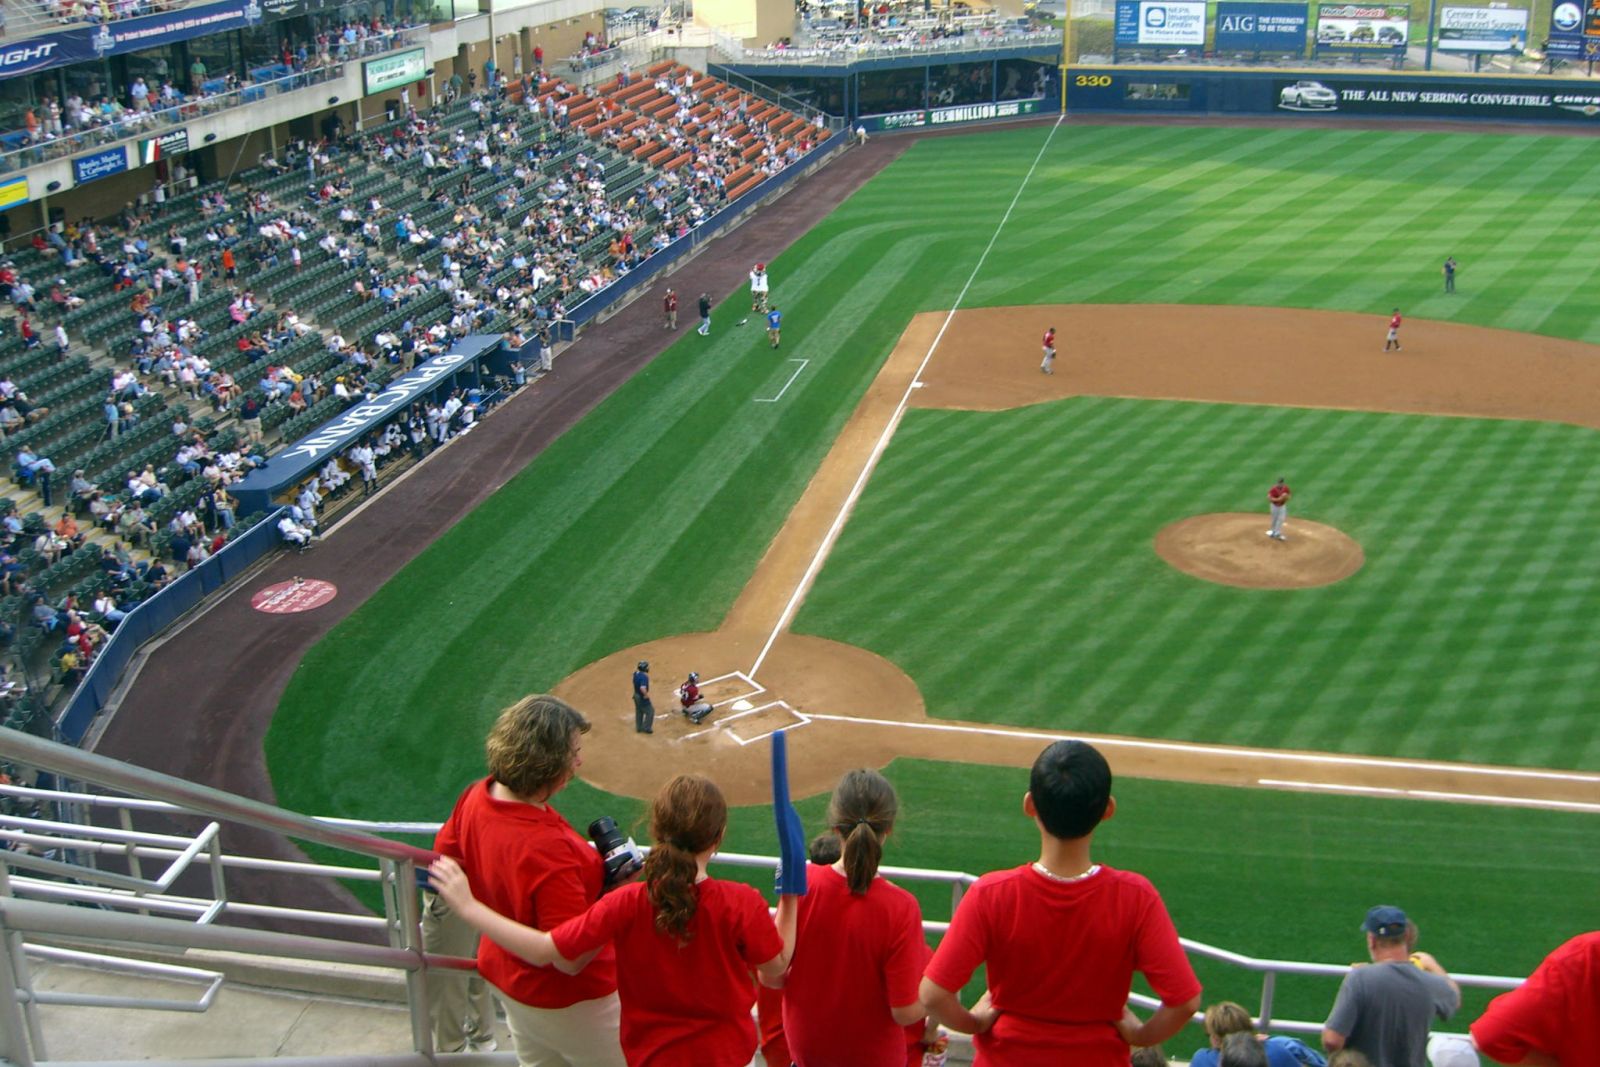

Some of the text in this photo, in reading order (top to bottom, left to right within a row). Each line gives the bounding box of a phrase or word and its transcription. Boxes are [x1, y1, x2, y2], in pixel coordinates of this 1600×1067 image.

[1222, 16, 1253, 32] AIG
[1075, 75, 1112, 87] 330
[1341, 90, 1365, 101] THE
[1366, 91, 1389, 102] ALL
[1391, 91, 1418, 103] NEW
[1419, 92, 1468, 104] SEBRING
[955, 105, 996, 122] MILLION
[282, 364, 452, 459] PNC BANK
